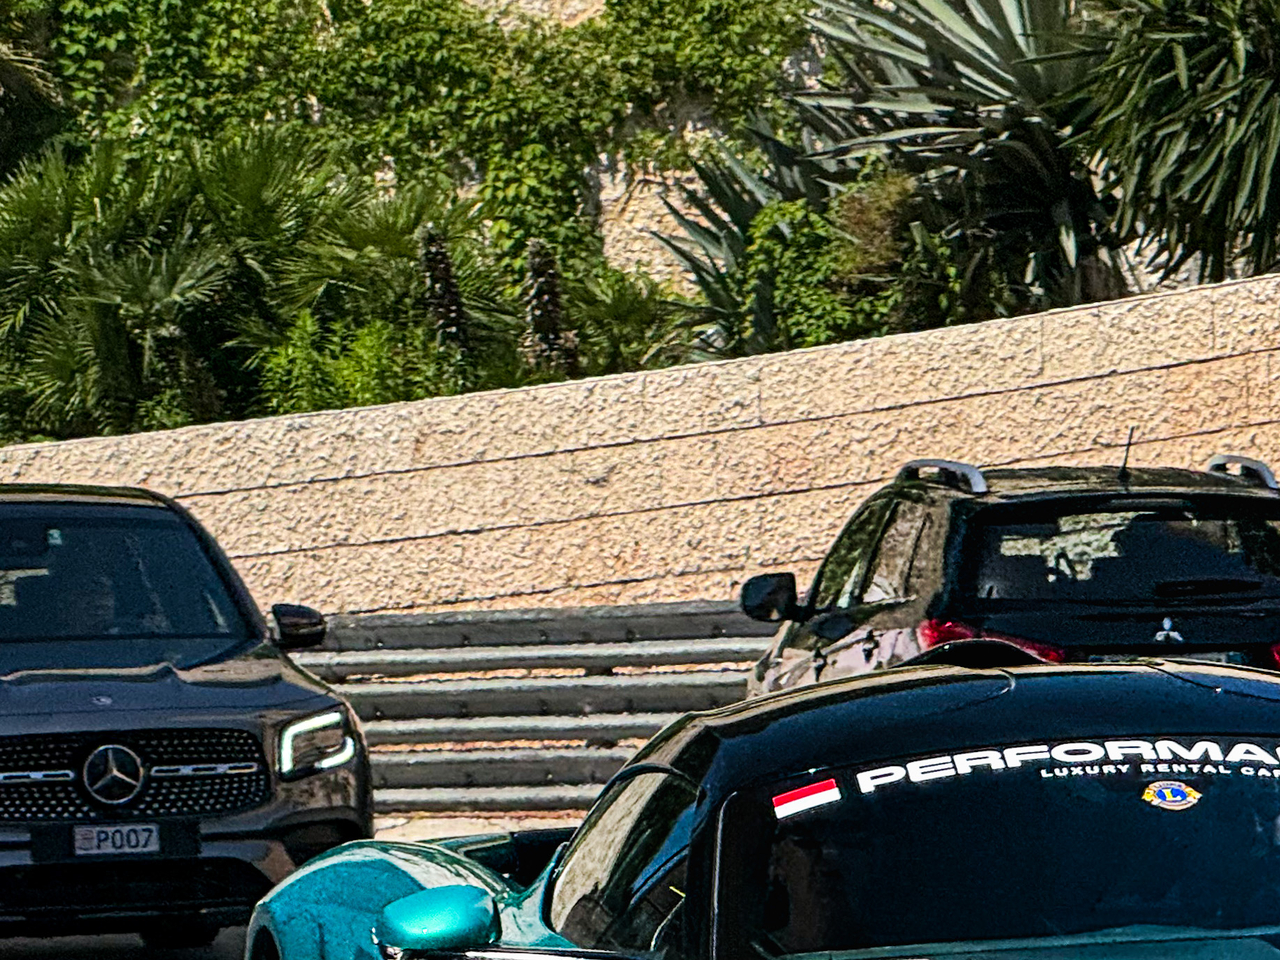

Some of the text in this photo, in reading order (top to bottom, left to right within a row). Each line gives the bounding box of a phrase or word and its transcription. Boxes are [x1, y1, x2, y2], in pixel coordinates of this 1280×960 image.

[1040, 764, 1130, 778] LUXURY
[1140, 763, 1232, 774] RENTAL
[96, 827, 154, 850] P007
